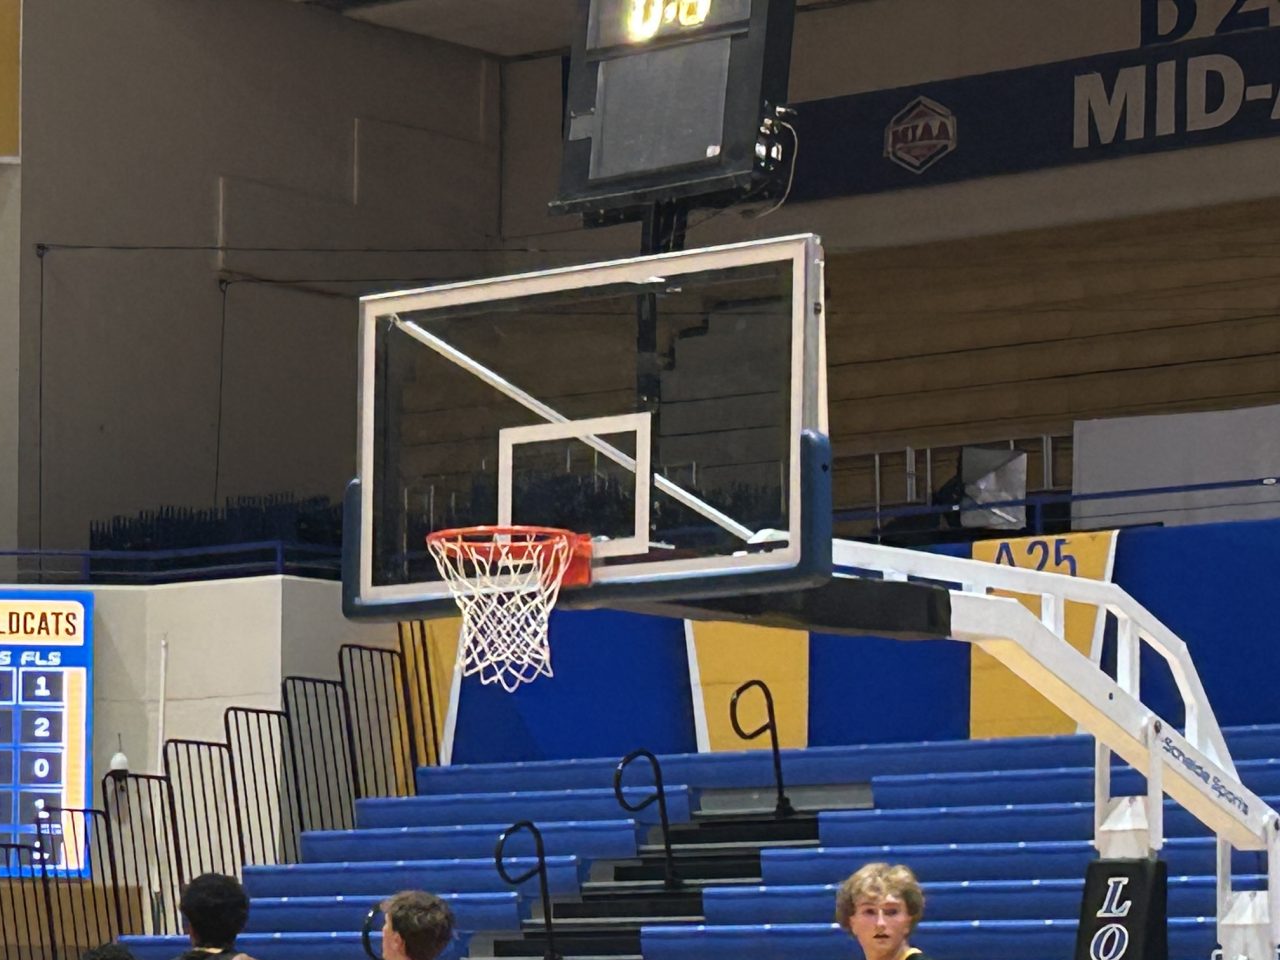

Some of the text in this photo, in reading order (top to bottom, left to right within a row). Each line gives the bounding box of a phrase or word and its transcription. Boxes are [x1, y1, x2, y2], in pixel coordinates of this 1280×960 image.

[1073, 54, 1280, 148] MID-
[21, 651, 62, 666] FLS
[34, 675, 51, 697] 1
[34, 717, 50, 738] 2
[33, 758, 50, 778] 0
